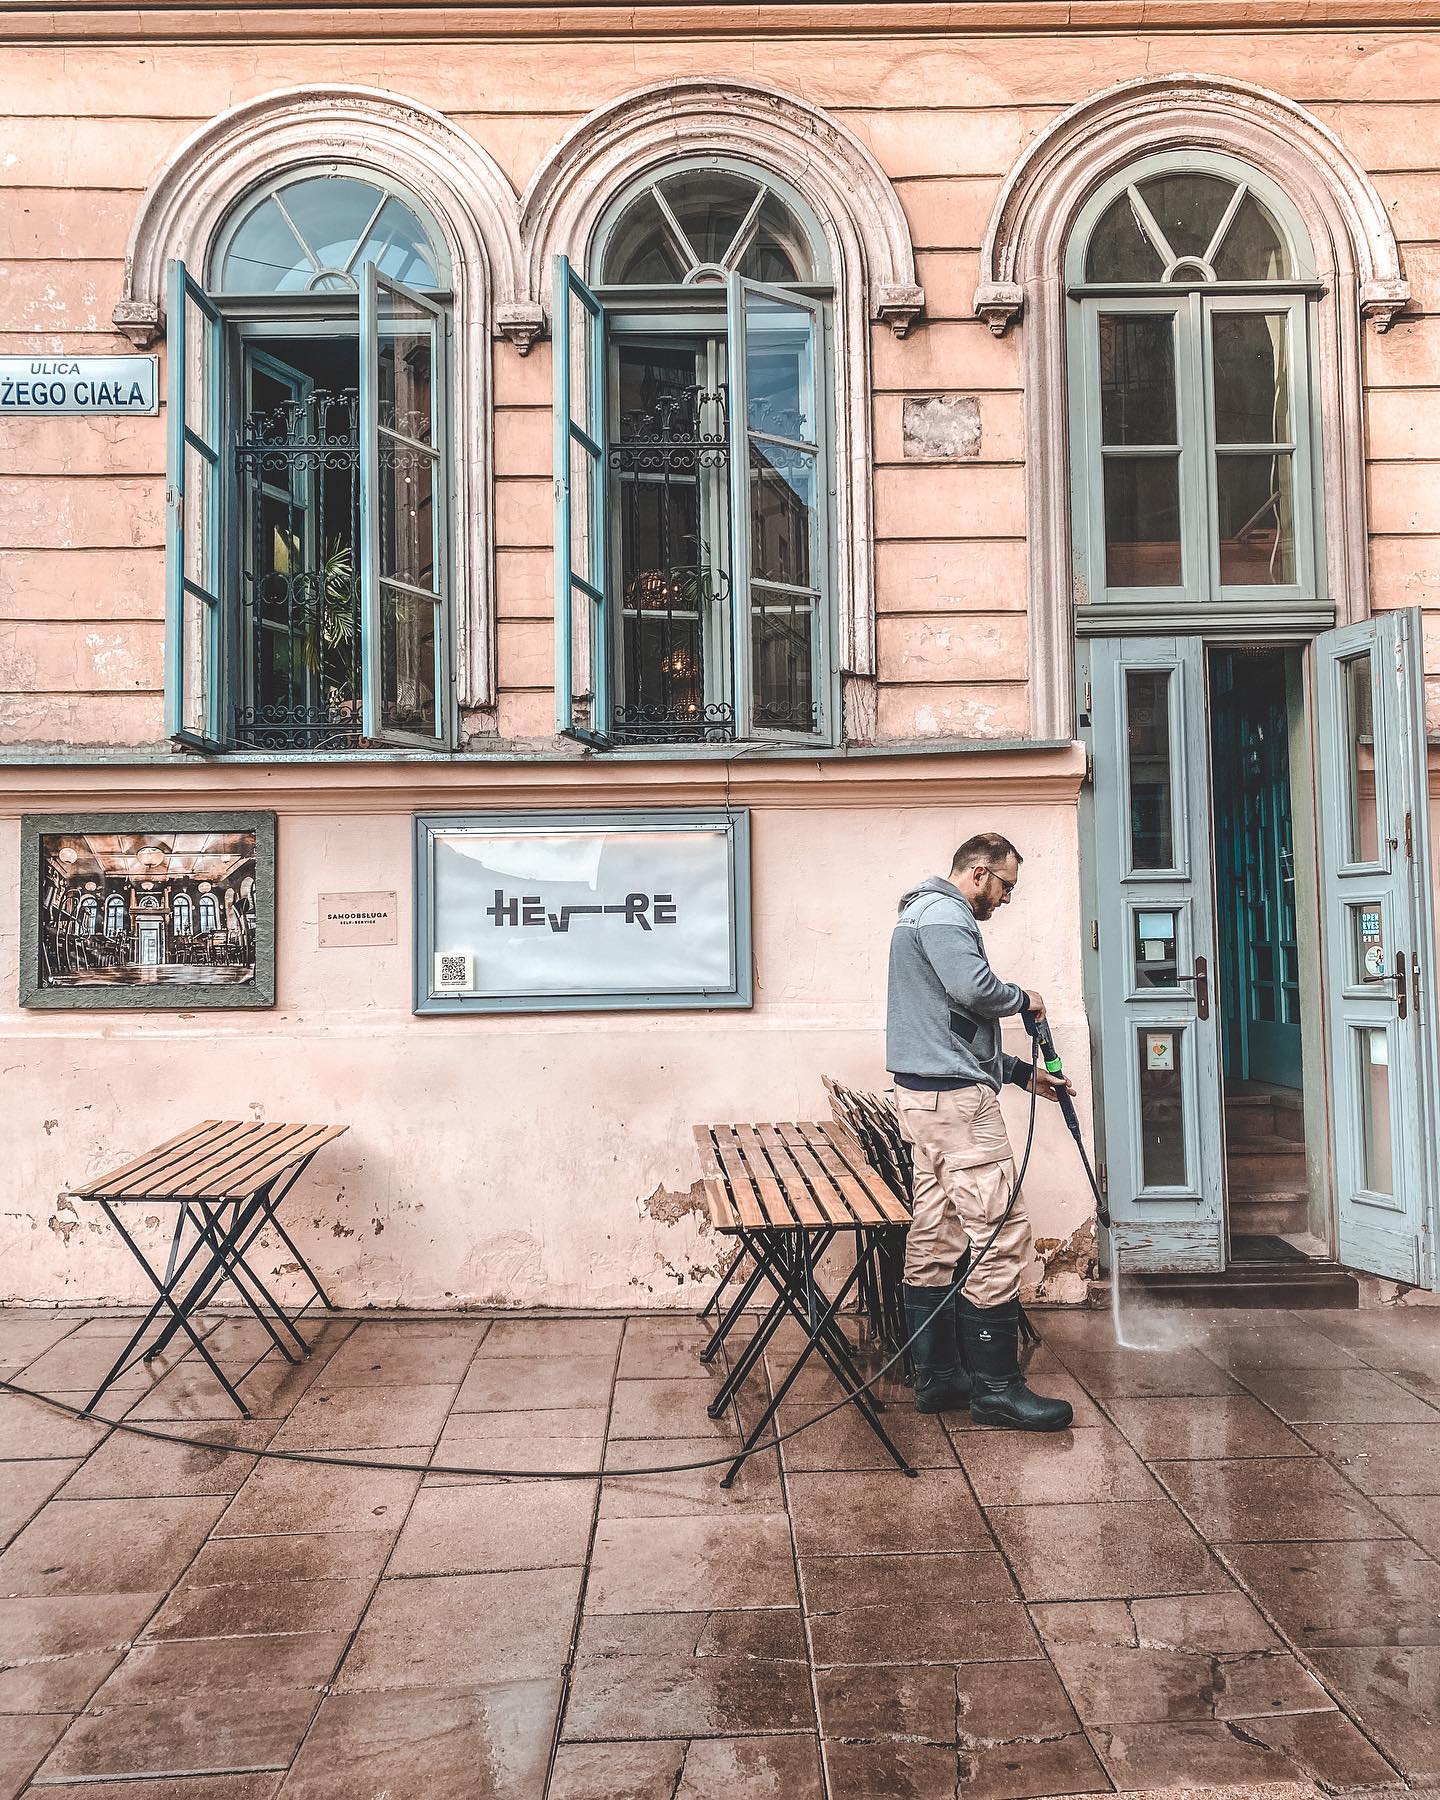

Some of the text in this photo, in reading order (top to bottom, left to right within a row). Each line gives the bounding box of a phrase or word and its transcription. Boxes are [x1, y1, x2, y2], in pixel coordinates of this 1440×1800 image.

[31, 363, 80, 375] ULICA
[1, 376, 145, 405] ŻEGO CIAŁA
[1362, 913, 1379, 922] OPEN
[1362, 921, 1380, 930] EYES
